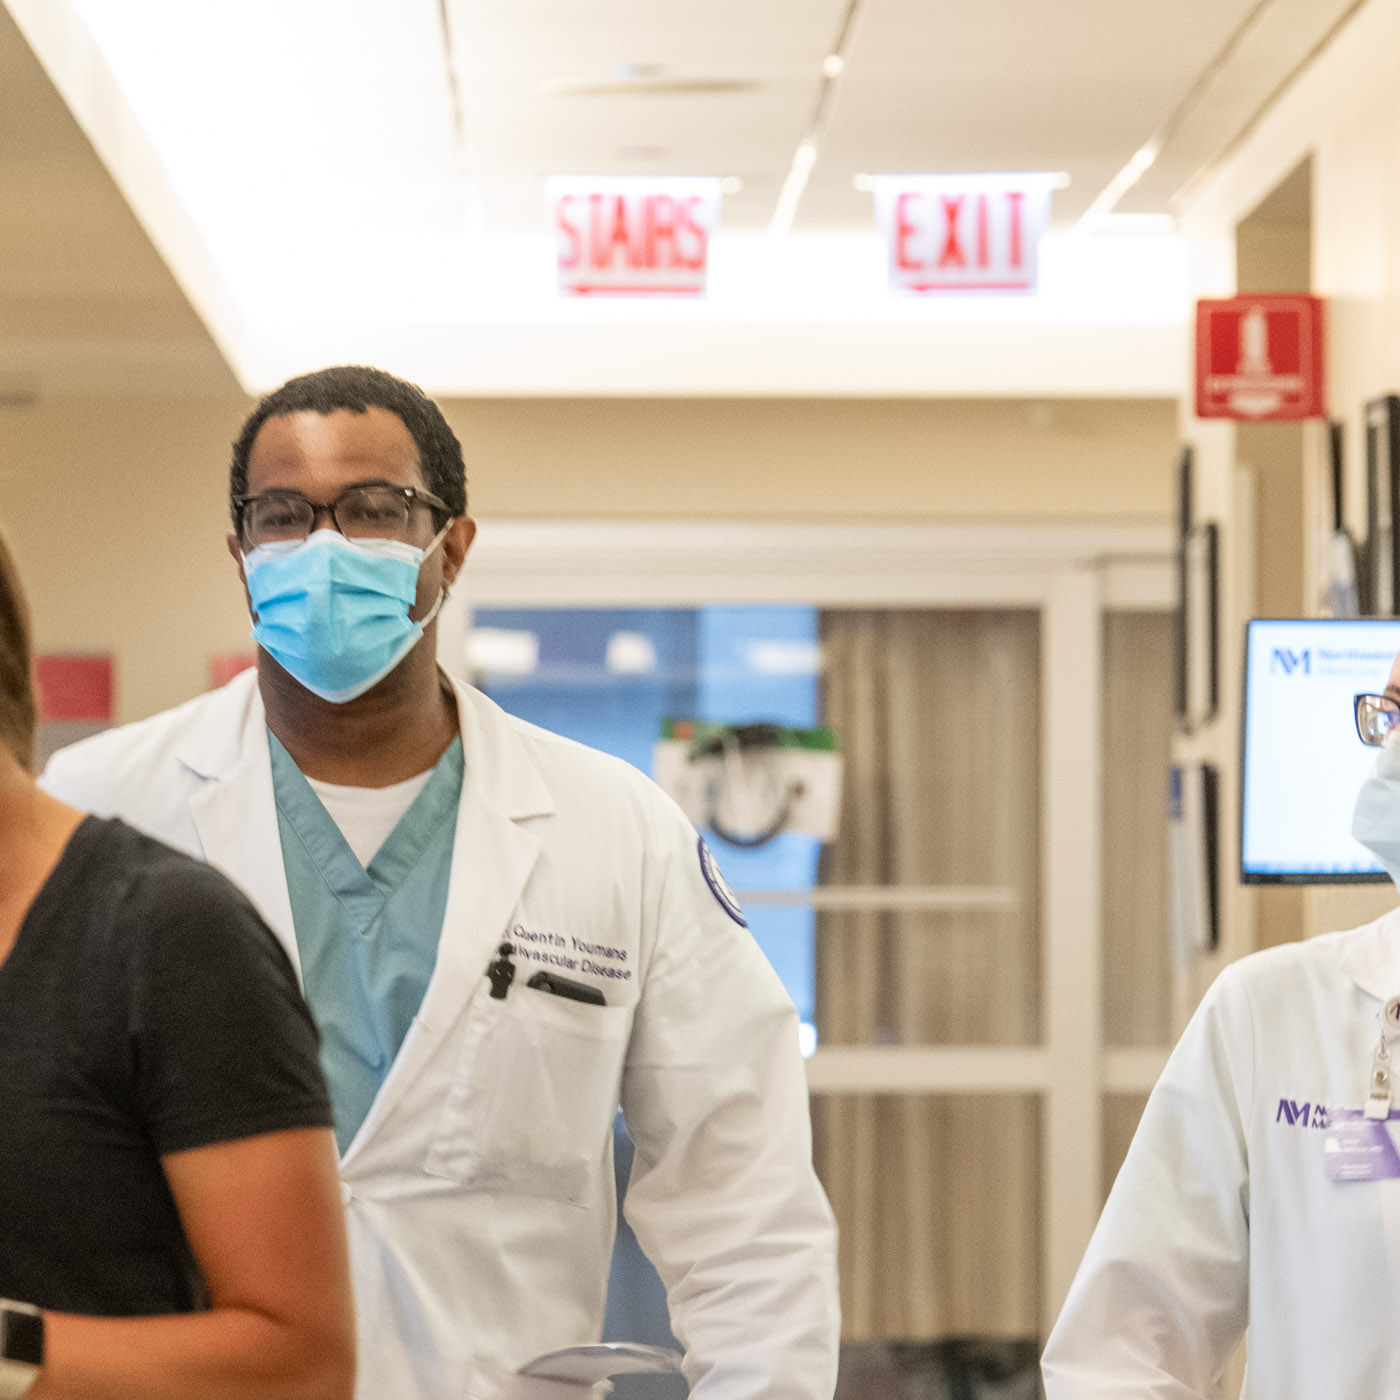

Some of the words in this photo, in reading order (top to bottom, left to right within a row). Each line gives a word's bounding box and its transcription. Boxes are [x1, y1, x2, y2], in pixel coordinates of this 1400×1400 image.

[558, 195, 708, 271] STAIRS
[896, 192, 1025, 270] EXIT
[513, 924, 566, 948] Quentin
[571, 935, 627, 961] Youmans
[581, 958, 631, 980] Disease
